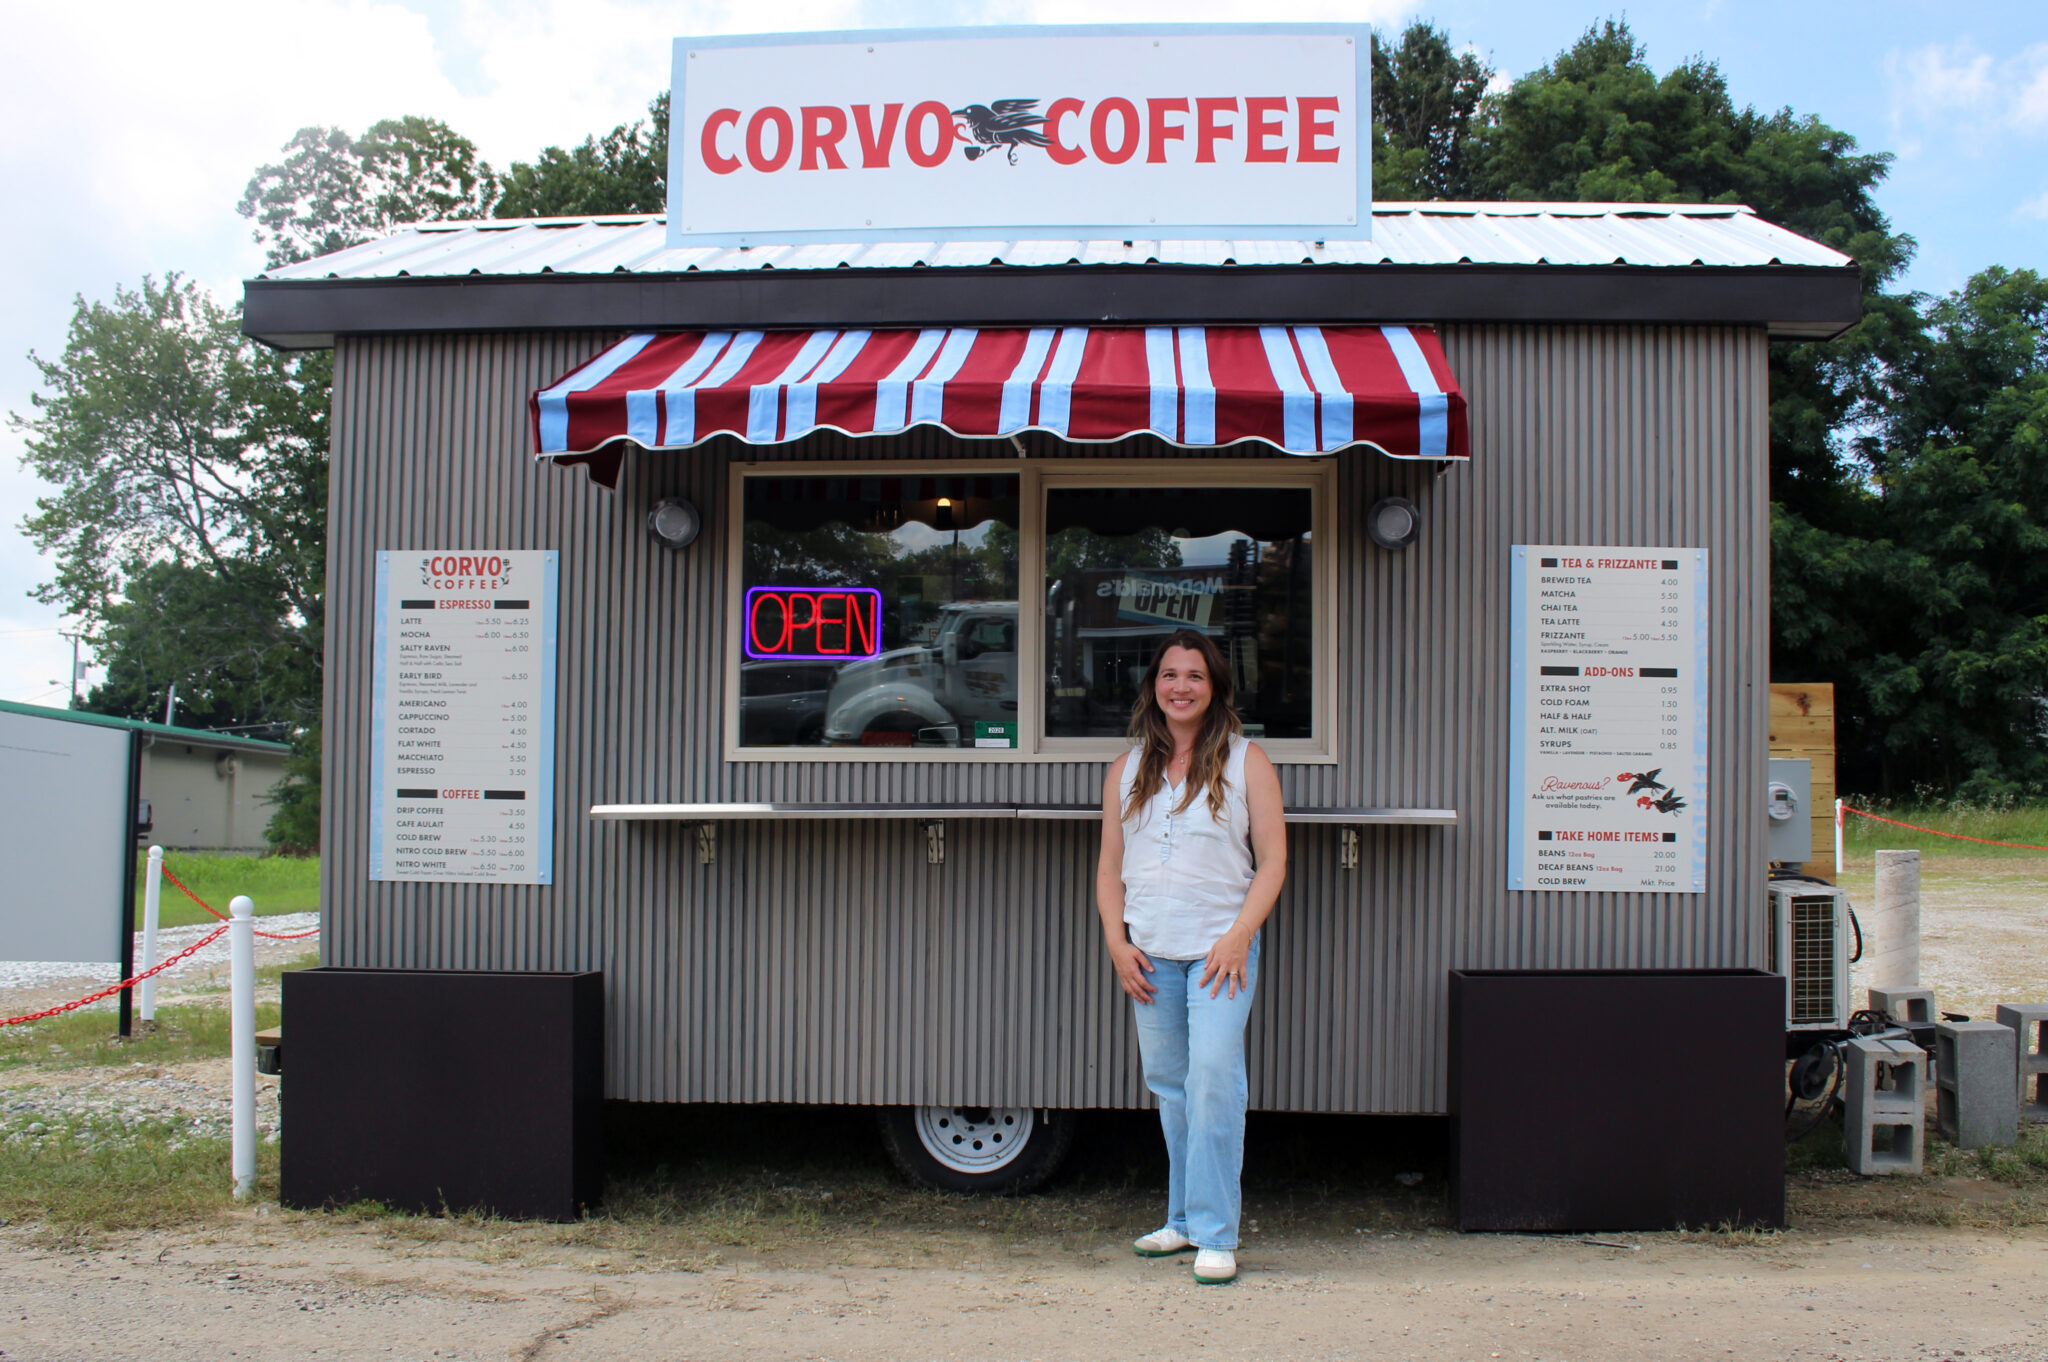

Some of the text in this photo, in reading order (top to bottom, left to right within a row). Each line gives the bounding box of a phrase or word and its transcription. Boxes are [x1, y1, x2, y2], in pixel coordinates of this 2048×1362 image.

[701, 96, 1341, 176] CORVO COFFEE
[431, 557, 502, 576] CORVO
[1562, 559, 1658, 570] TEA & FRIZZANTE
[434, 580, 498, 590] COFFEE
[440, 600, 491, 610] ESPRESSO
[1135, 587, 1200, 621] OPEN
[750, 593, 875, 655] OPEN
[1584, 667, 1634, 677] ADD-ONS
[1541, 776, 1611, 792] Ravenous?
[442, 790, 480, 800] COFFEE
[1556, 831, 1659, 842] TAKE HOME ITEMS
